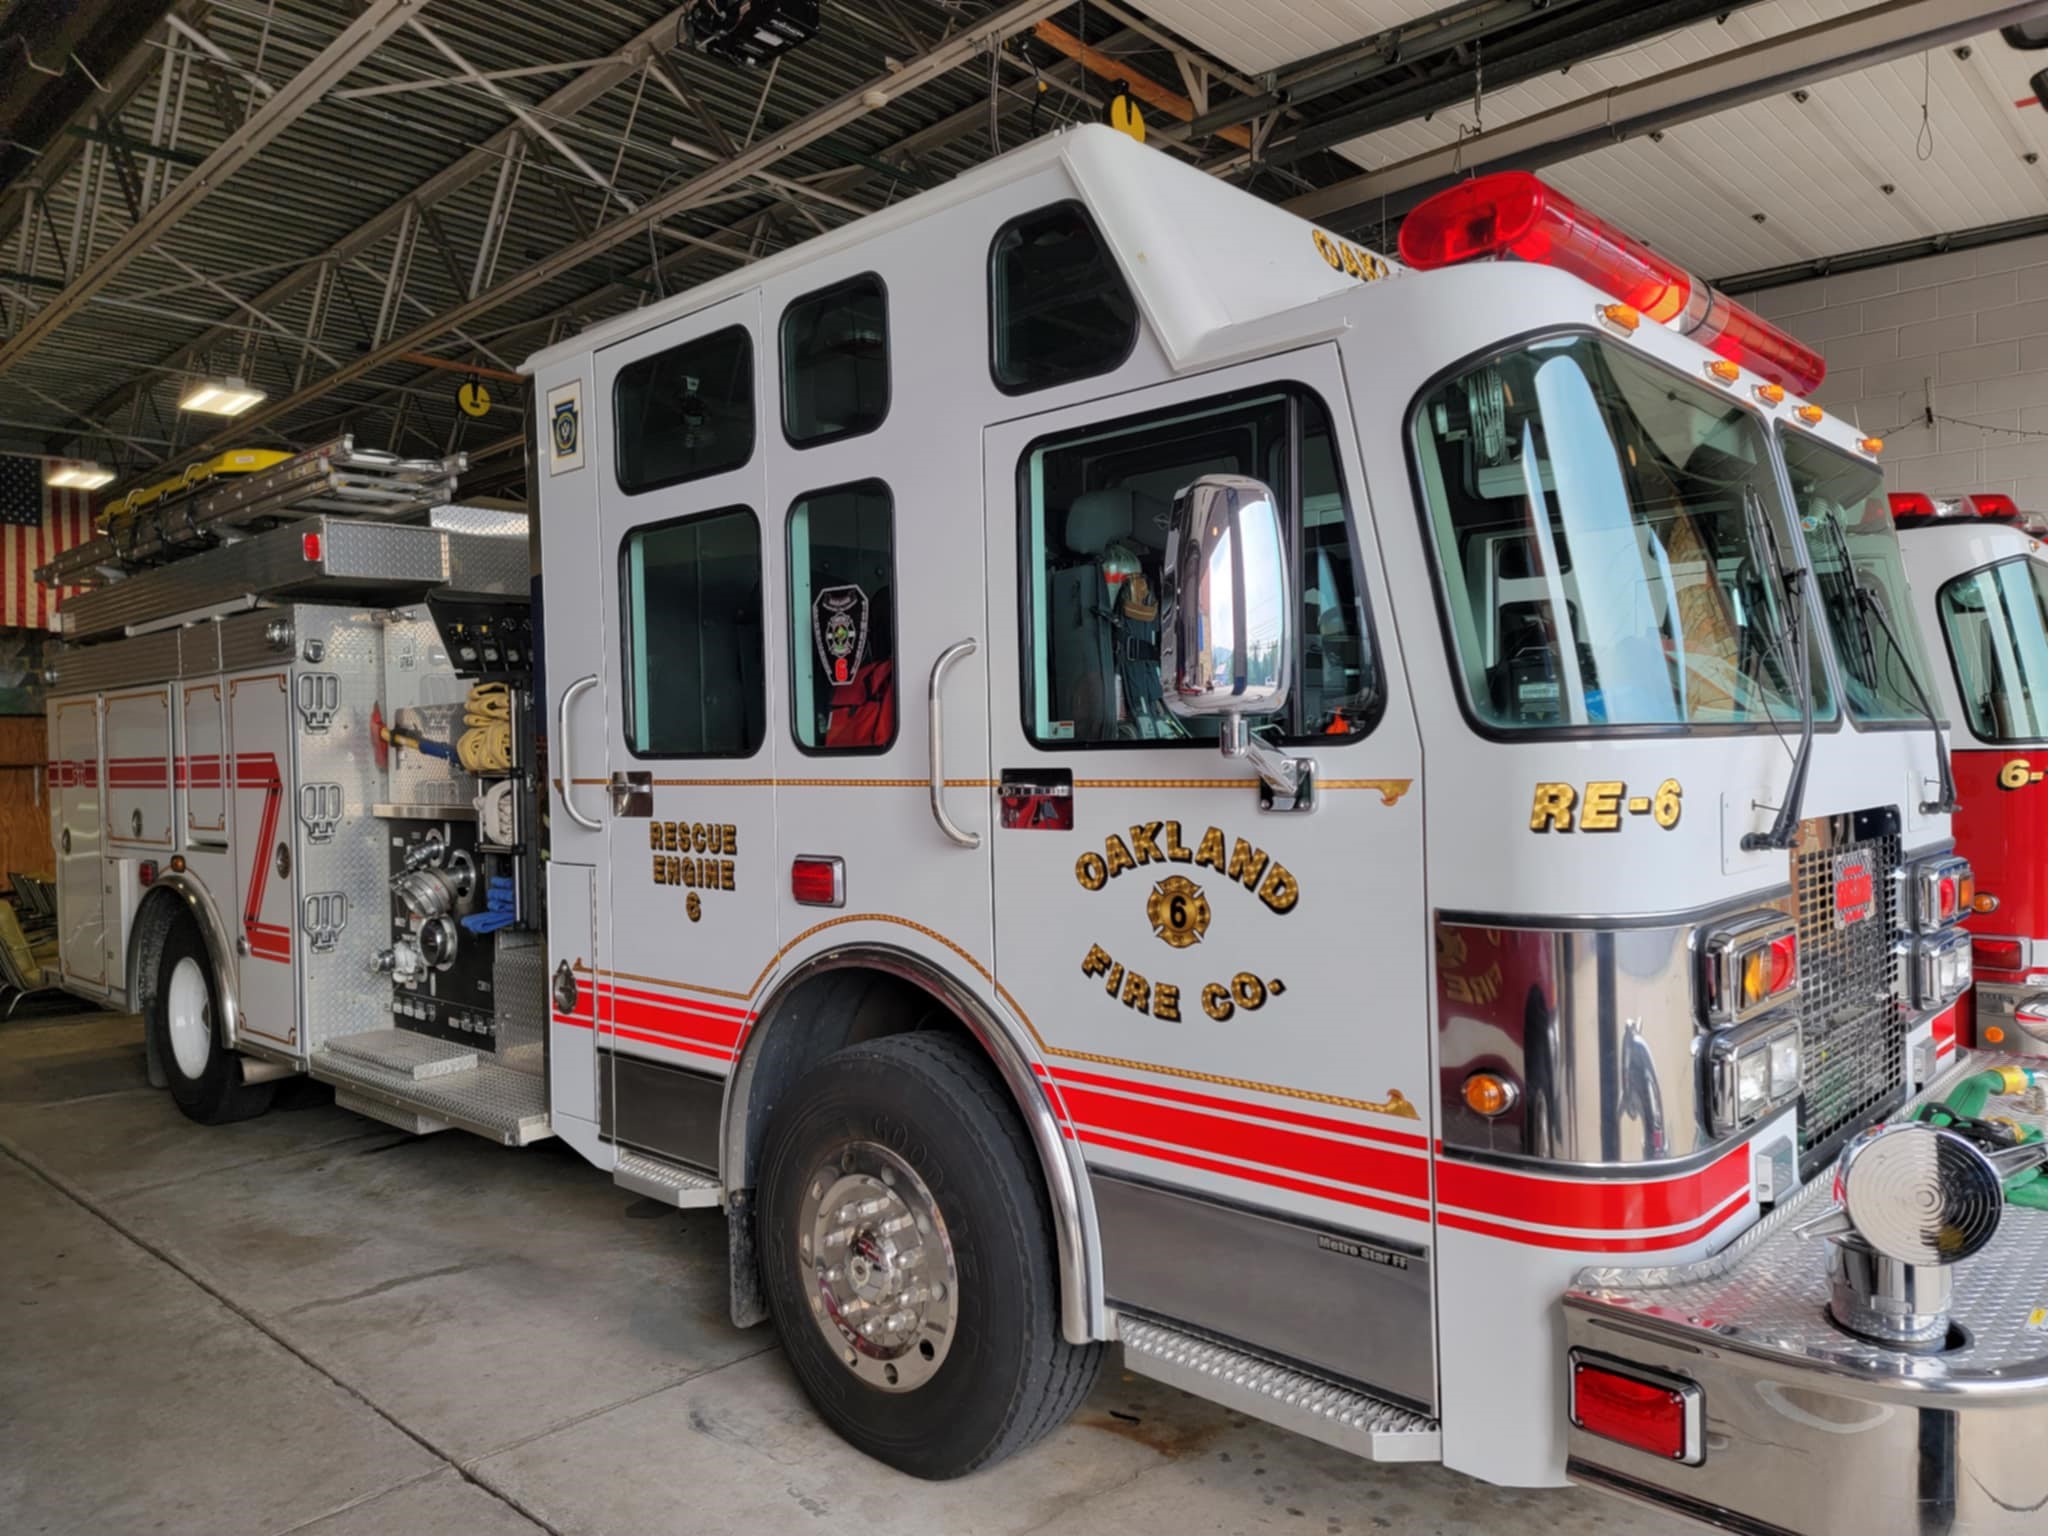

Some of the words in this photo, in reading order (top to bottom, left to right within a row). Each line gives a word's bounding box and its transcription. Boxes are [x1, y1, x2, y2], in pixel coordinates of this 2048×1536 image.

[1312, 228, 1389, 281] OAK
[1530, 778, 1683, 833] RE-6
[650, 821, 738, 855] RESCUE
[653, 854, 736, 891] ENGINE
[1075, 820, 1299, 915] OAKLAND
[686, 891, 702, 922] 6
[1170, 895, 1187, 928] 6
[1081, 943, 1182, 1023] FIRE
[1201, 971, 1287, 1022] CO.
